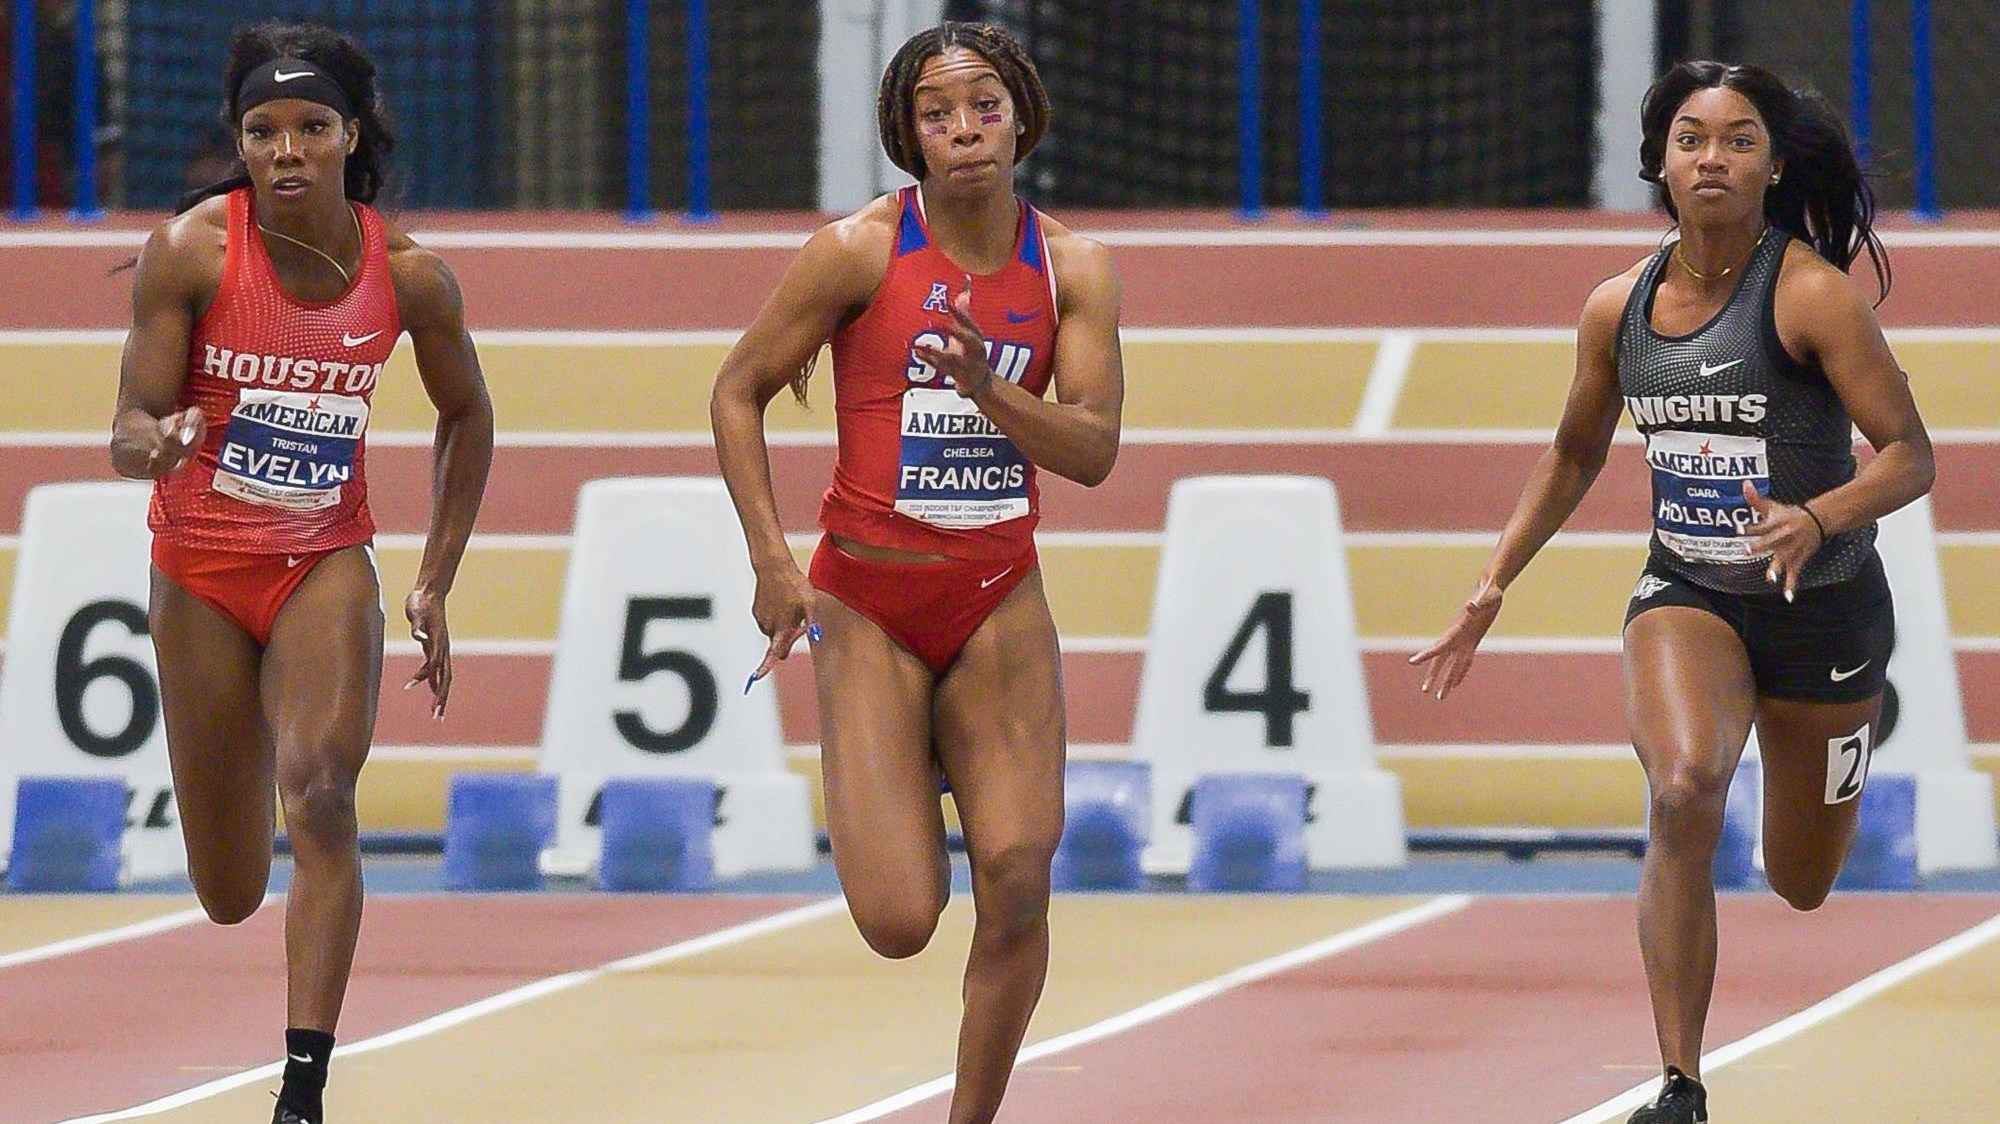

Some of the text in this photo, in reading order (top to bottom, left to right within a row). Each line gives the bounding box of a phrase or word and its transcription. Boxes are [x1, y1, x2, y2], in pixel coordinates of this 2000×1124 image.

[907, 332, 1031, 384] SU
[239, 403, 358, 435] AMERICAN
[907, 412, 1000, 435] AMERIC
[1624, 394, 1768, 425] NIGHTS
[272, 437, 318, 454] TRISTAN
[943, 447, 995, 458] CHELSEA
[222, 442, 349, 485] EVELYN
[900, 464, 1024, 491] FRANCIS
[1652, 450, 1759, 477] AMERICAN
[1686, 487, 1721, 499] CIARA
[55, 600, 158, 757] 6
[612, 596, 718, 754] 5
[1203, 591, 1311, 747] 4
[1836, 736, 1862, 800] 2
